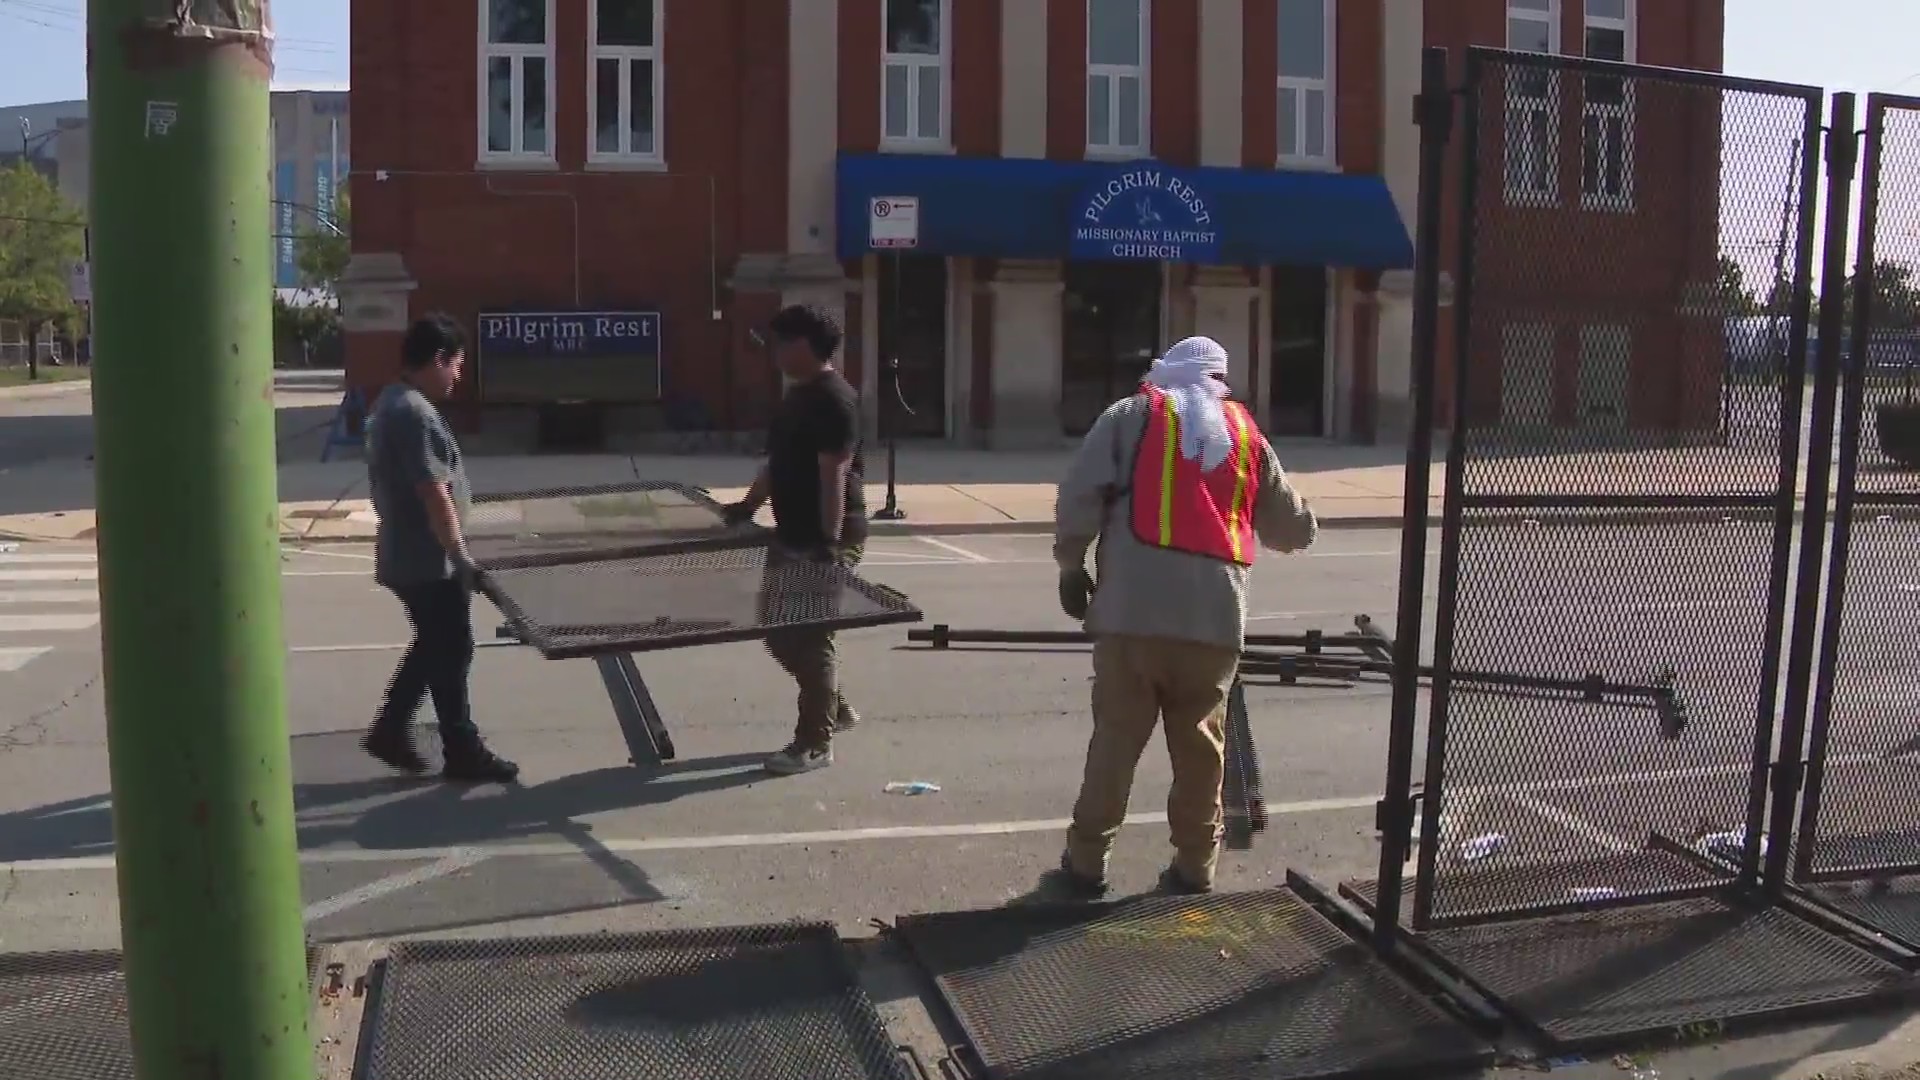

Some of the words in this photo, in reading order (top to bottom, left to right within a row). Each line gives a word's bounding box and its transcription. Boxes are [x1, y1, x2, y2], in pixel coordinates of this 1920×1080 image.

[1085, 171, 1161, 222] PILGRIM
[1167, 177, 1211, 225] REST
[1077, 228, 1159, 242] MISSIONARY
[1163, 230, 1216, 244] BAPTIST
[1112, 244, 1181, 258] CHURCH
[488, 317, 584, 343] Pilgrim
[594, 318, 651, 337] Rest
